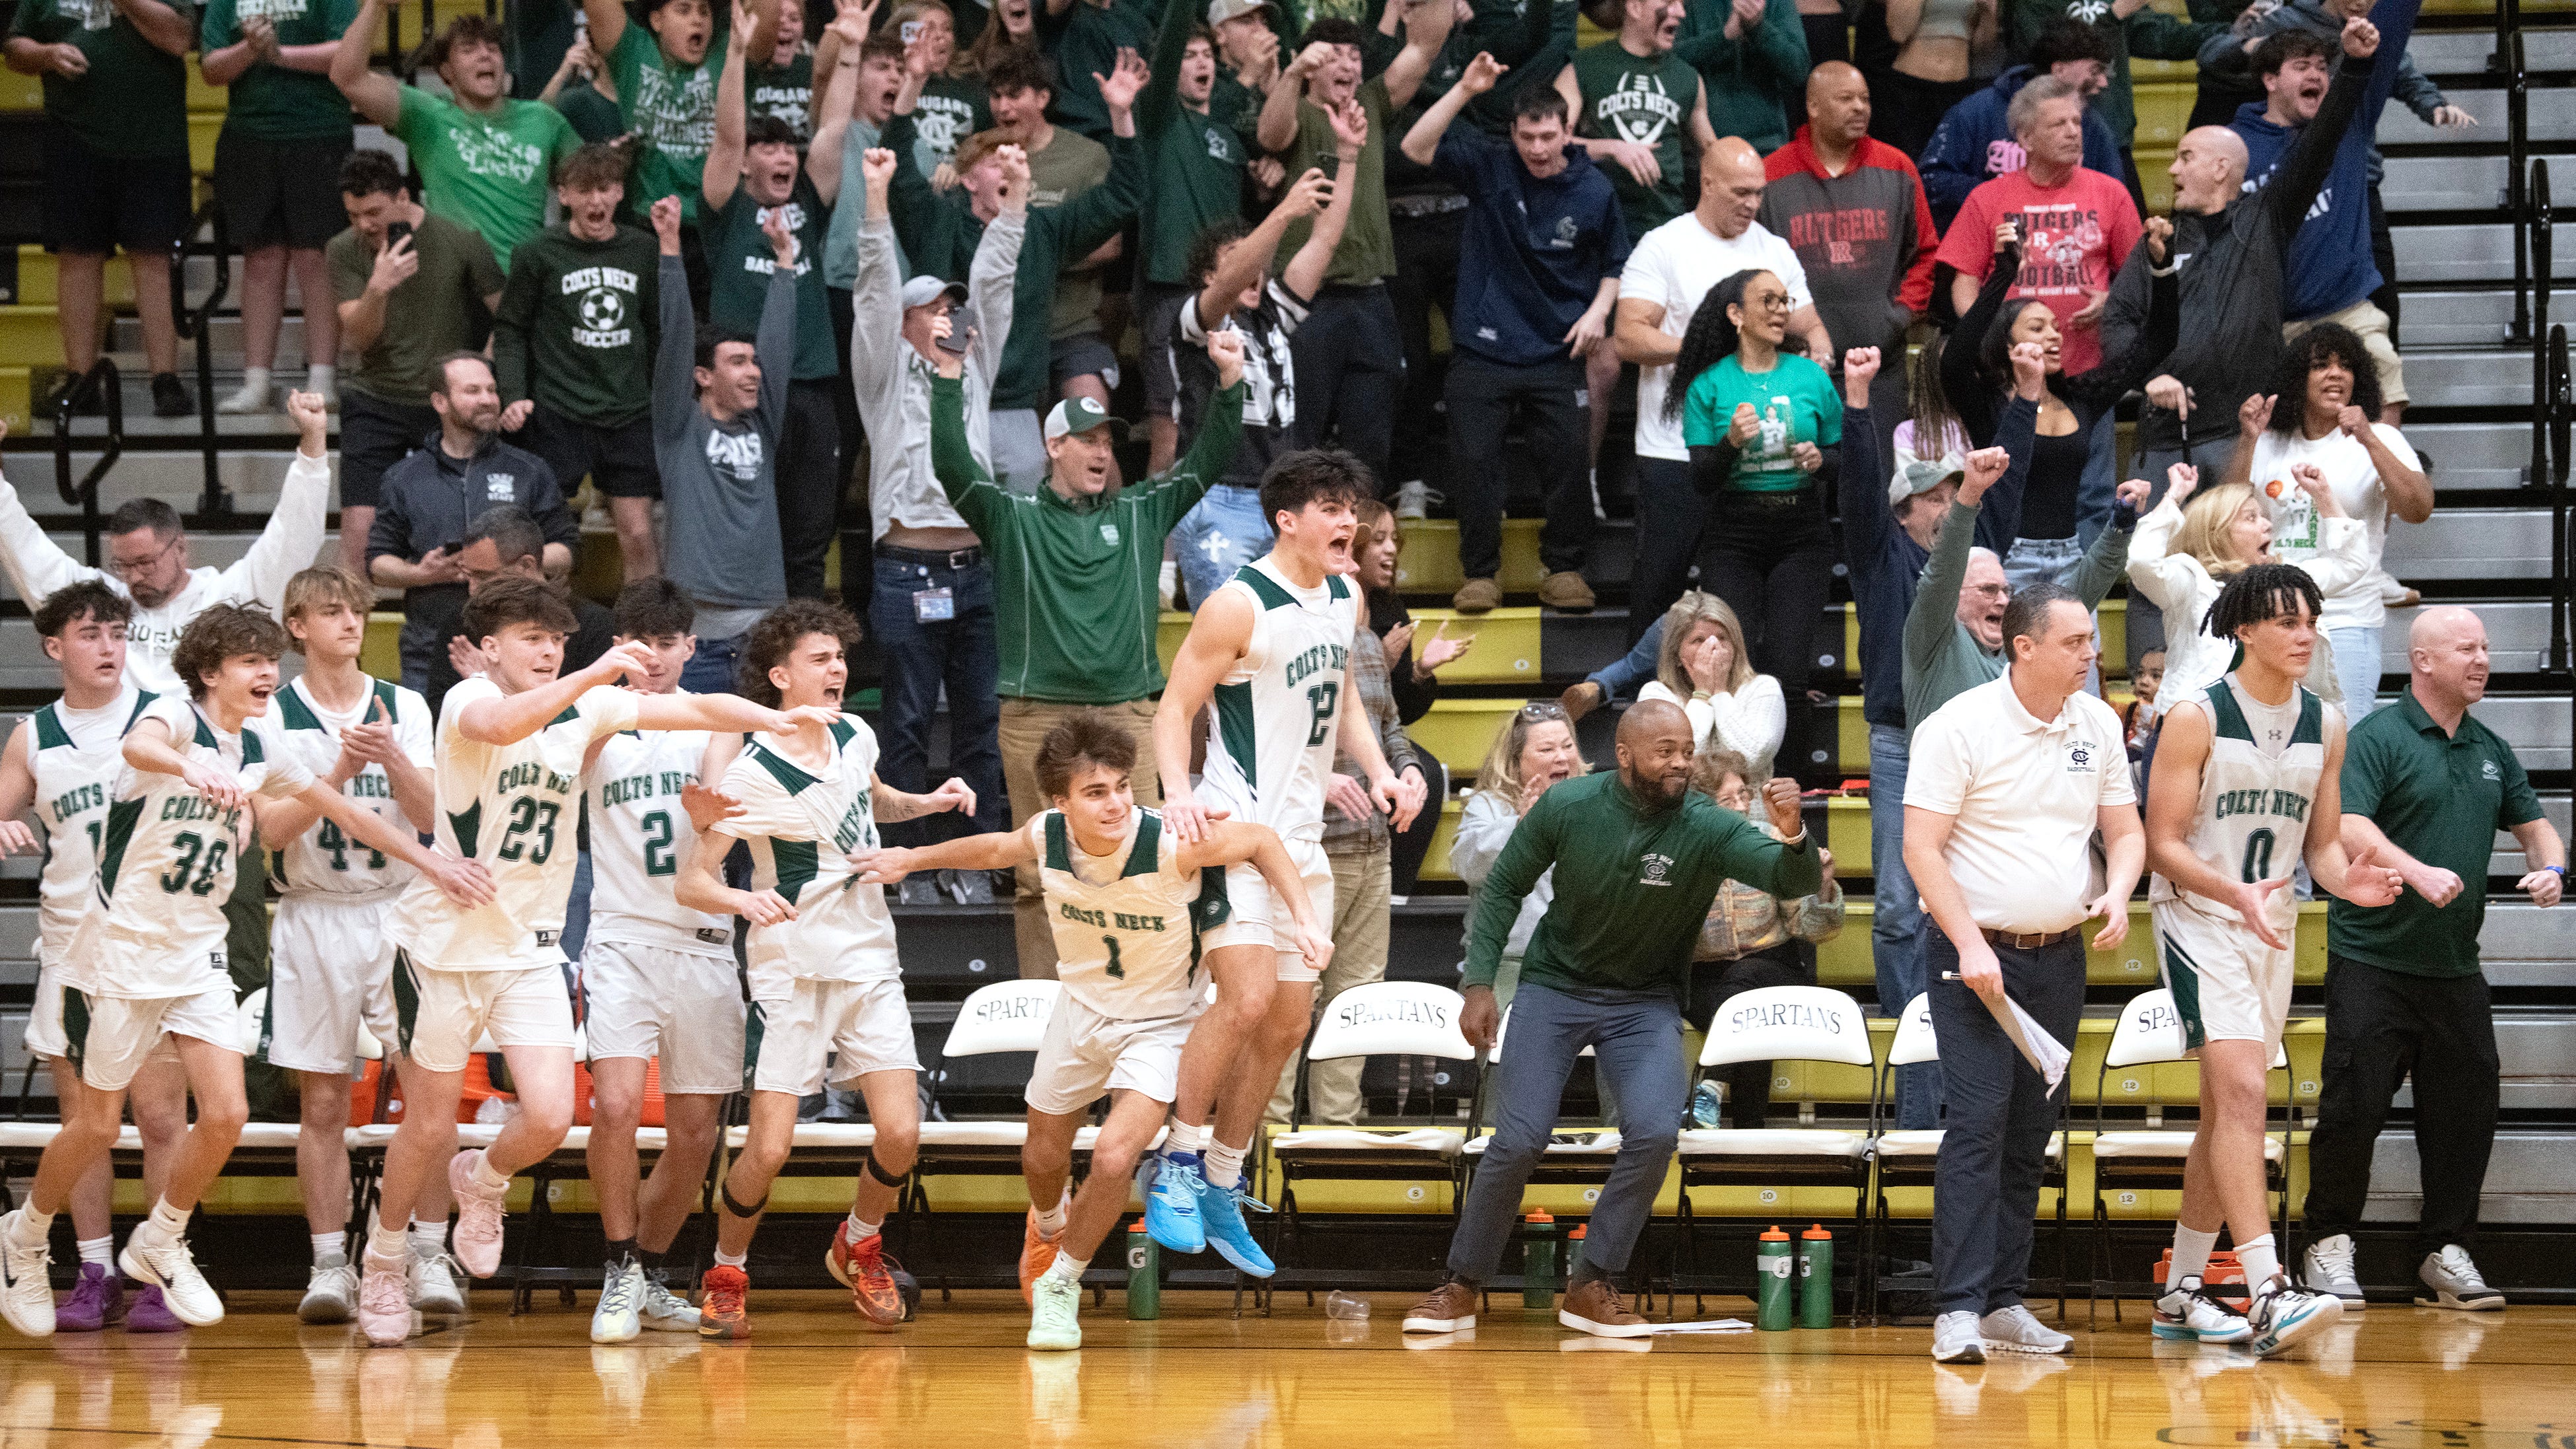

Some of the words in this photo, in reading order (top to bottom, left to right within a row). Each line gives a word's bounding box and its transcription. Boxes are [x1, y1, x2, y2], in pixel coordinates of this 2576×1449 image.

[1598, 90, 1642, 119] COLTS
[1644, 91, 1680, 125] NECK
[1791, 208, 1887, 250] RUTGERS
[561, 266, 601, 295] COLTS
[601, 266, 639, 295] NECK
[2015, 265, 2094, 287] OOTBALL
[571, 326, 631, 349] SOCCER
[1286, 643, 1327, 689] COLTS
[1330, 643, 1349, 672] NE
[1306, 681, 1338, 747] 12
[52, 782, 104, 824] COLTS
[353, 772, 395, 798] NEC
[602, 773, 653, 809] COLTS
[660, 770, 701, 796] NE
[2270, 789, 2310, 824] NECK
[497, 795, 562, 866] 23
[640, 808, 677, 877] 2
[159, 830, 230, 898] 30
[2240, 827, 2277, 884] 0
[1112, 911, 1166, 933] NECK
[1102, 934, 1126, 981] 1
[976, 997, 1053, 1025] SPART
[1732, 1003, 1842, 1034] SPARTANS
[1129, 1247, 1147, 1269] G
